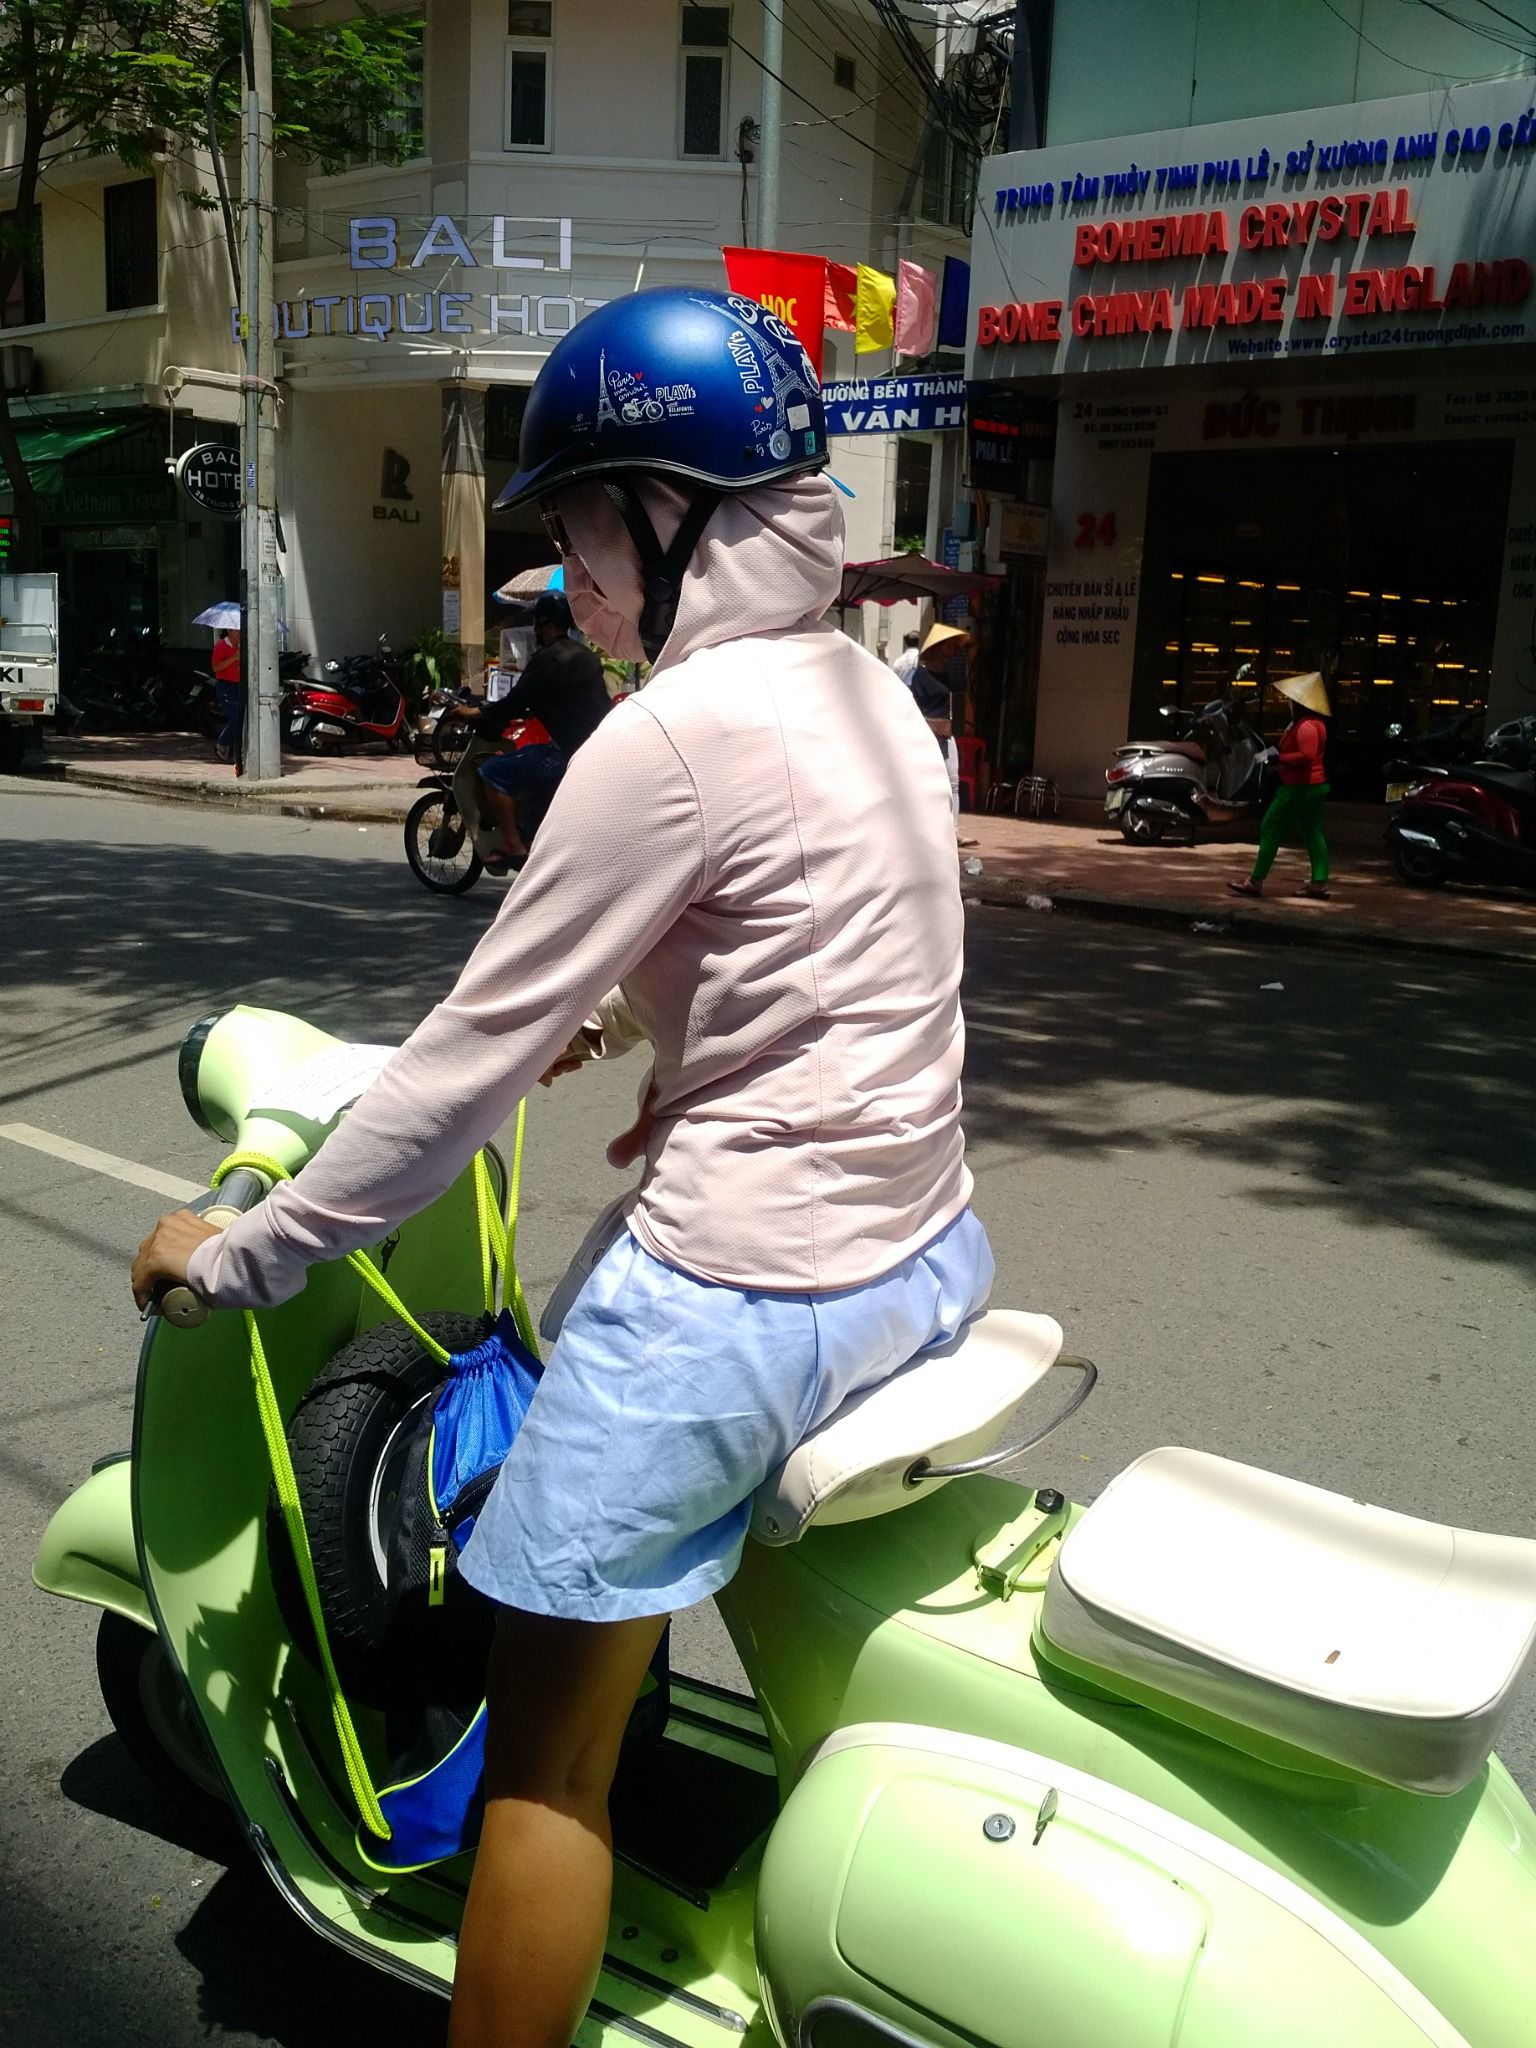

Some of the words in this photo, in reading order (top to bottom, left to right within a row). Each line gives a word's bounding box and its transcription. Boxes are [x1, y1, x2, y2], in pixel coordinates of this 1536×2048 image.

[996, 182, 1055, 211] TRUNG
[1061, 172, 1099, 204] TÂM
[1156, 163, 1198, 193] TINH
[1203, 158, 1241, 187] PHA
[1246, 148, 1270, 181] LÊ
[1393, 131, 1438, 164] ANH
[1445, 126, 1491, 157] CAO
[1074, 210, 1229, 267] BOHEMIA
[1239, 188, 1417, 252] CRYSTAL
[350, 214, 572, 270] BALI
[977, 300, 1063, 347] BONE
[1071, 288, 1173, 338] CHINA
[1183, 277, 1287, 328] MADE
[1295, 273, 1335, 319] IN
[1344, 258, 1532, 316] ENGLAND
[231, 292, 473, 343] UTIQUE
[1291, 323, 1526, 351] www.crystal24truongdinh.com
[608, 370, 635, 390] Paris
[822, 380, 869, 403] HƯỜNG
[873, 379, 908, 400] BẾN
[912, 378, 967, 398] THÀNH
[842, 405, 919, 431] VĂN
[934, 405, 967, 427] H
[1075, 402, 1092, 418] 24
[201, 451, 239, 466] BAL
[187, 469, 241, 490] HOTE
[372, 505, 420, 524] BALI
[1074, 511, 1117, 548] 24
[1047, 579, 1082, 597] CHUYÊN
[1115, 583, 1122, 596] &
[1078, 603, 1102, 623] NHẬP
[1056, 626, 1080, 647] CỘNG
